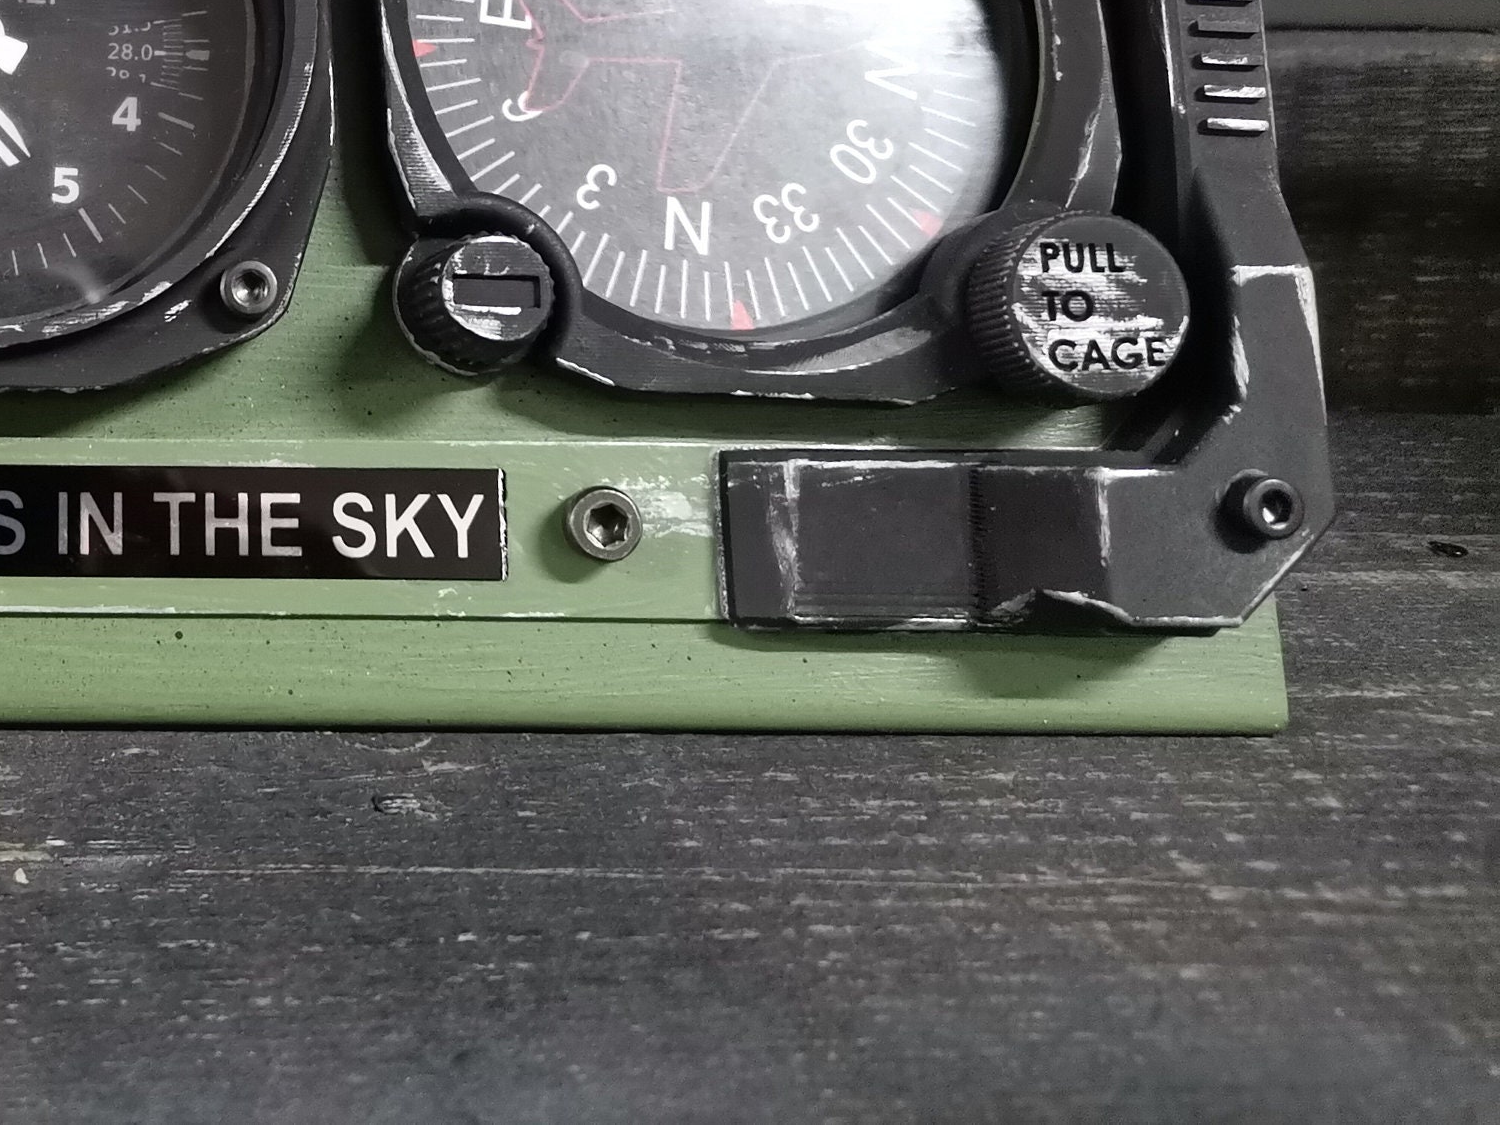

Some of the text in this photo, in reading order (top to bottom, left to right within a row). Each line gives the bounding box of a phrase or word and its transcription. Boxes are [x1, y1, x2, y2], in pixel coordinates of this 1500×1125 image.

[107, 41, 154, 62] 28.0
[111, 96, 142, 132] 4
[829, 119, 895, 185] 30
[51, 165, 80, 205] 5
[575, 163, 618, 210] 3
[663, 195, 714, 257] N
[752, 181, 821, 245] 33
[1039, 241, 1127, 274] PULL
[1041, 289, 1095, 322] TO
[1048, 336, 1166, 372] CAGE
[57, 490, 124, 556] IN
[153, 491, 303, 558] THE
[332, 491, 485, 559] SKY
